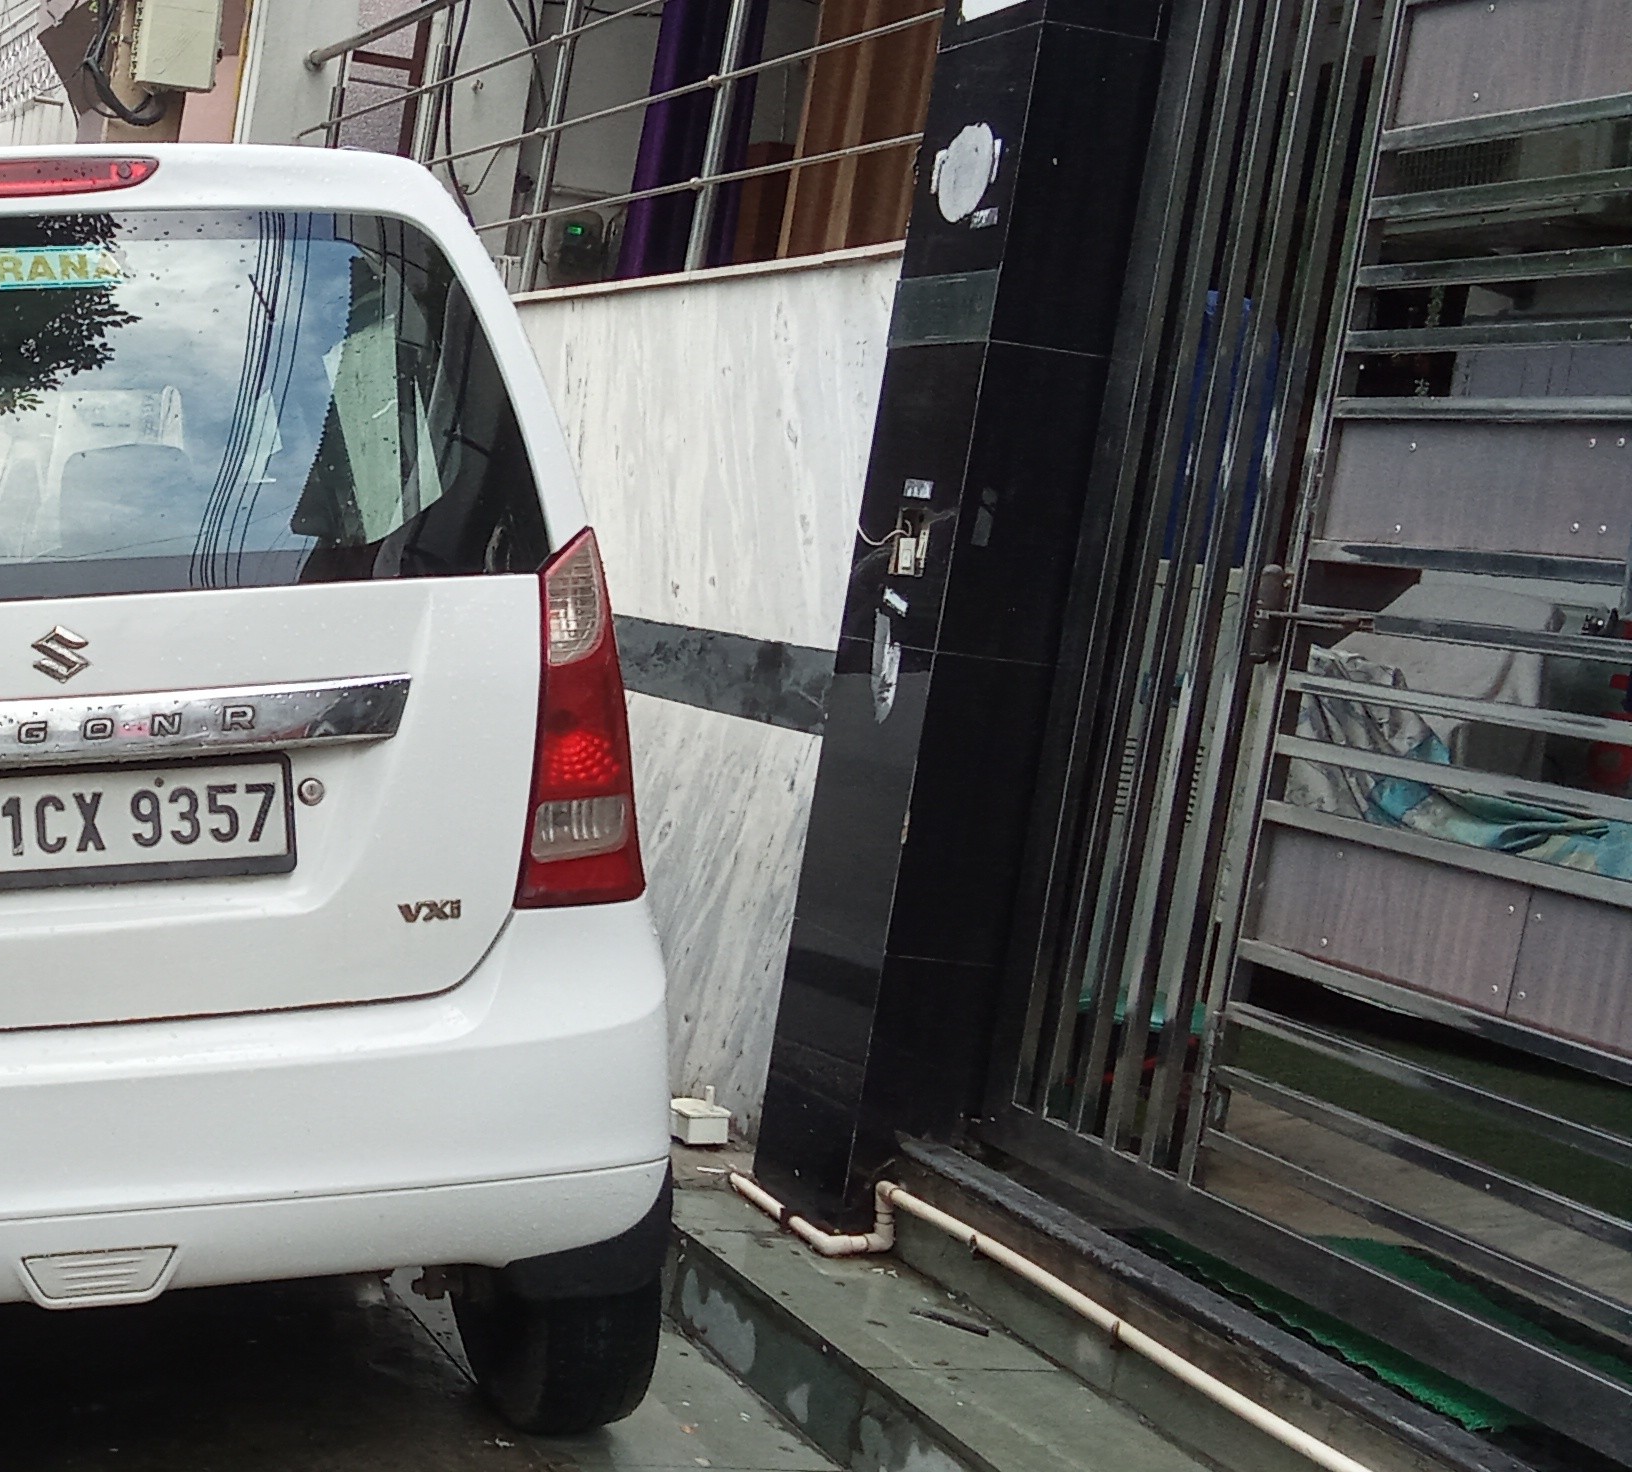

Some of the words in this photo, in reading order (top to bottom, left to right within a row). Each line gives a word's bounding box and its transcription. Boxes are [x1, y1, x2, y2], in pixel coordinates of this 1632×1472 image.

[221, 704, 258, 732] R
[1, 791, 106, 856] 1CX
[130, 783, 275, 849] 9357
